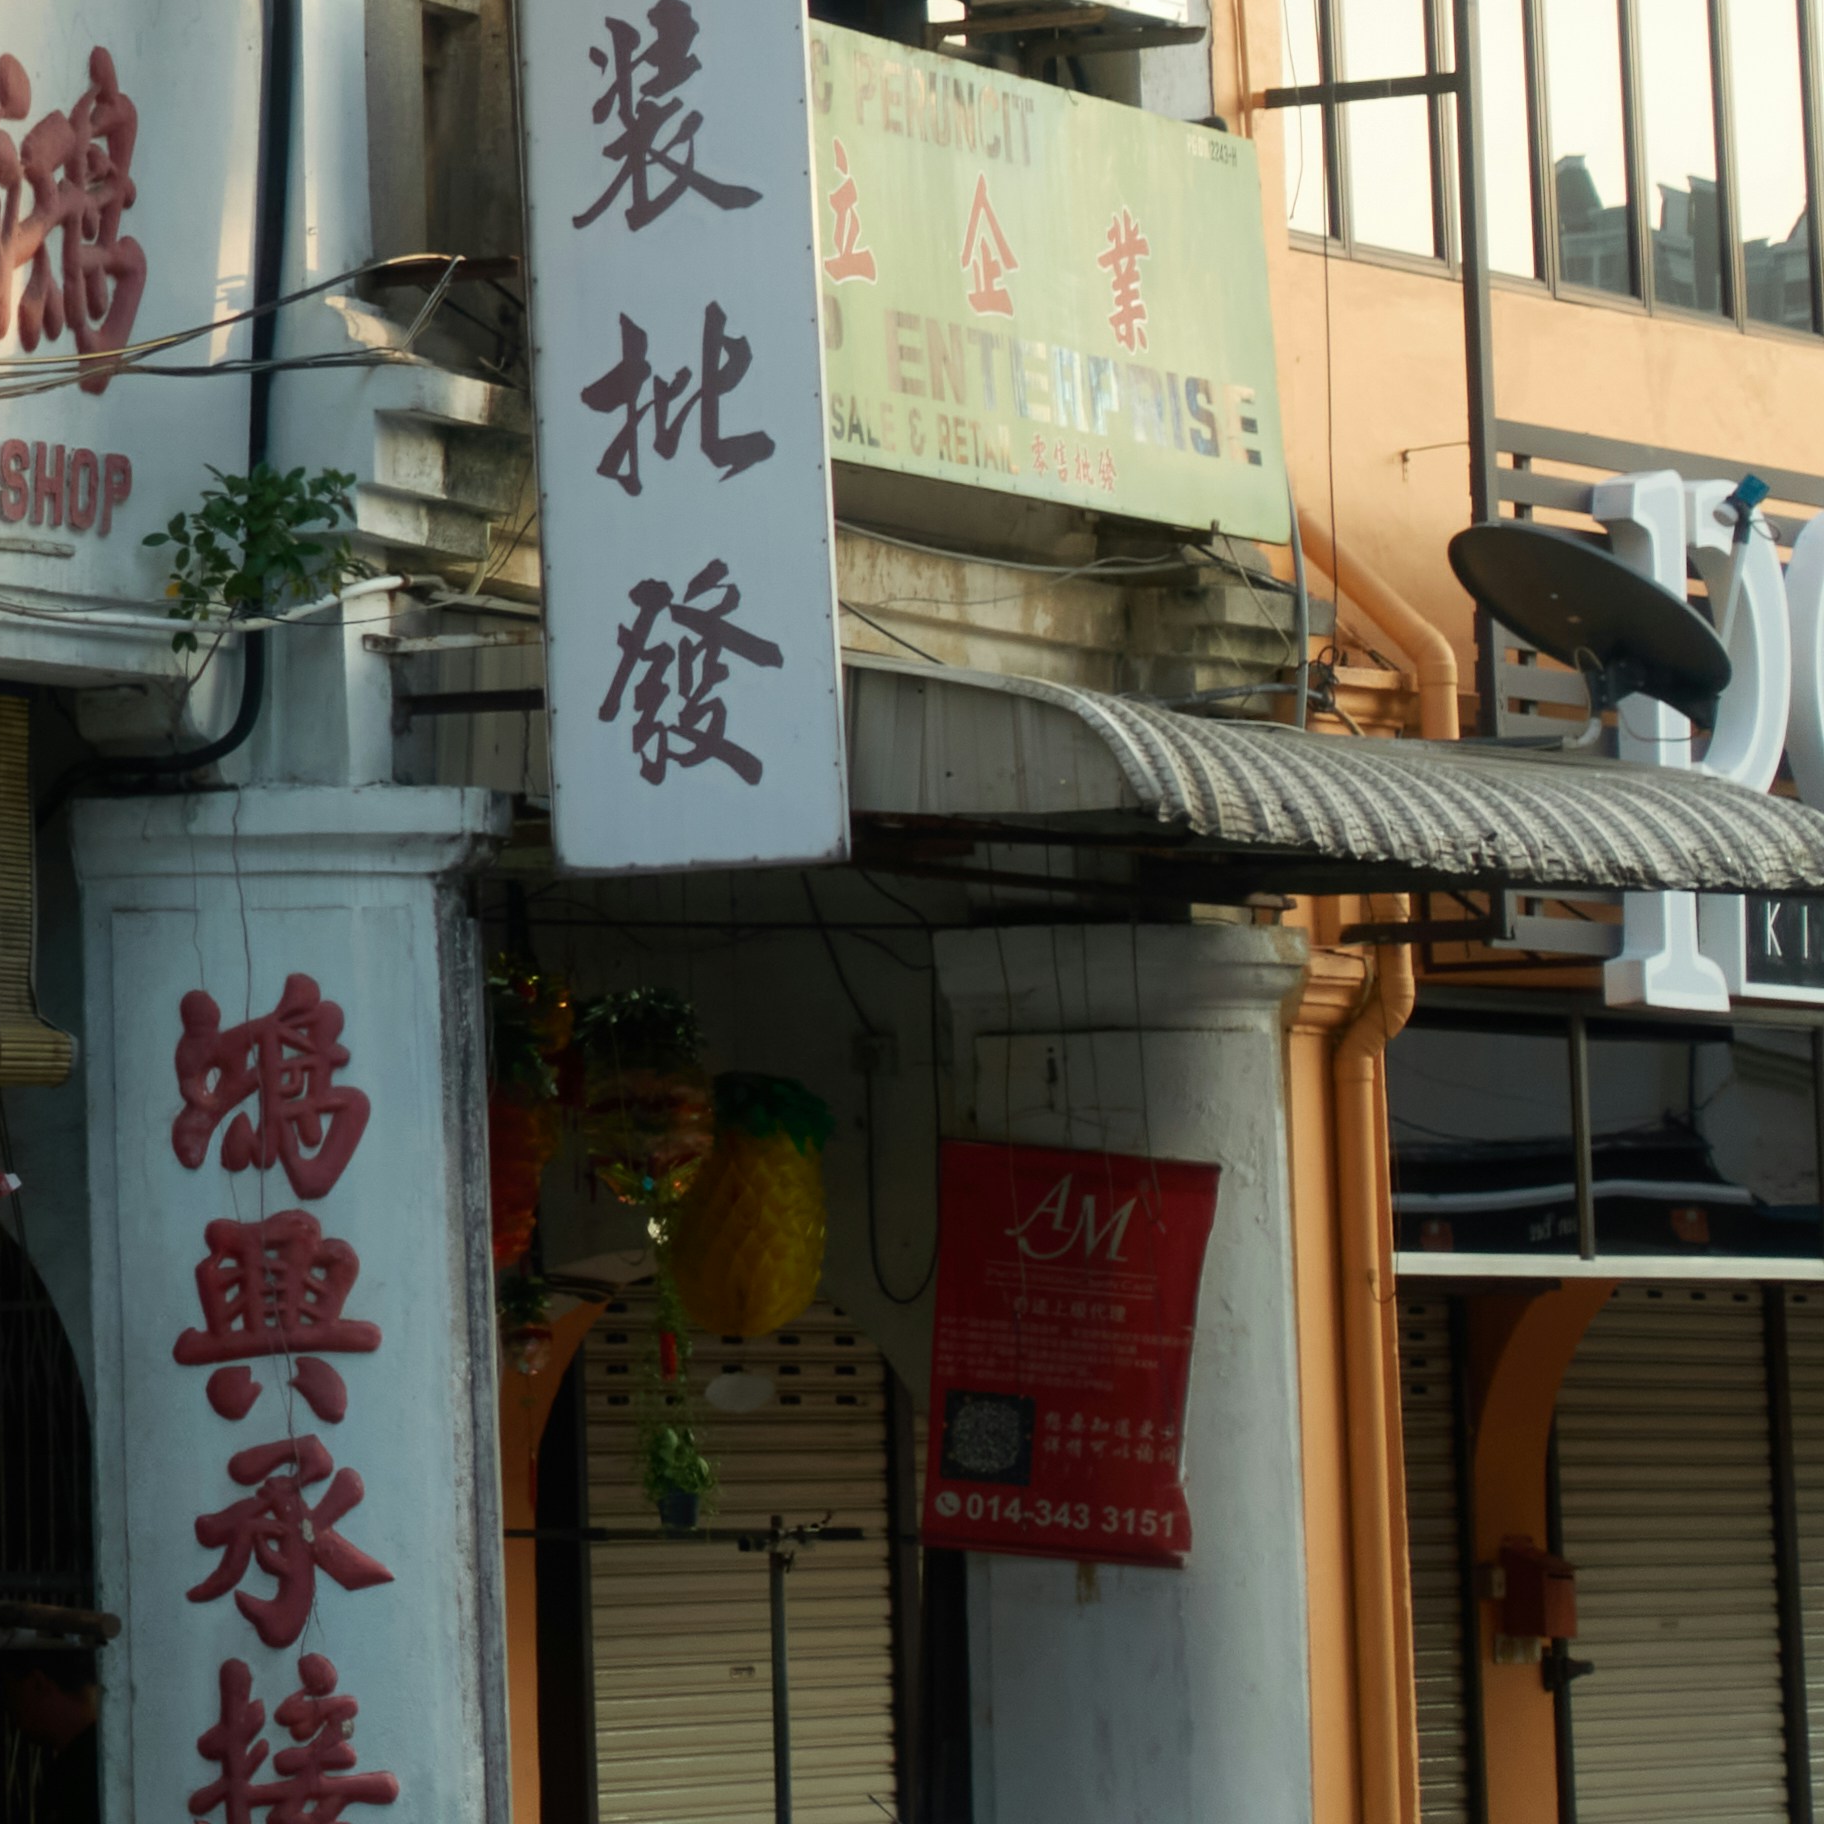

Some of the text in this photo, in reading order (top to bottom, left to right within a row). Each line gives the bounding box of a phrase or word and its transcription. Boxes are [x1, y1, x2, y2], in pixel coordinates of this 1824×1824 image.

[853, 50, 1036, 167] PERUNCIT
[884, 307, 1263, 469] ENTERPRISE
[966, 1492, 1176, 1540] 014-343 3151
